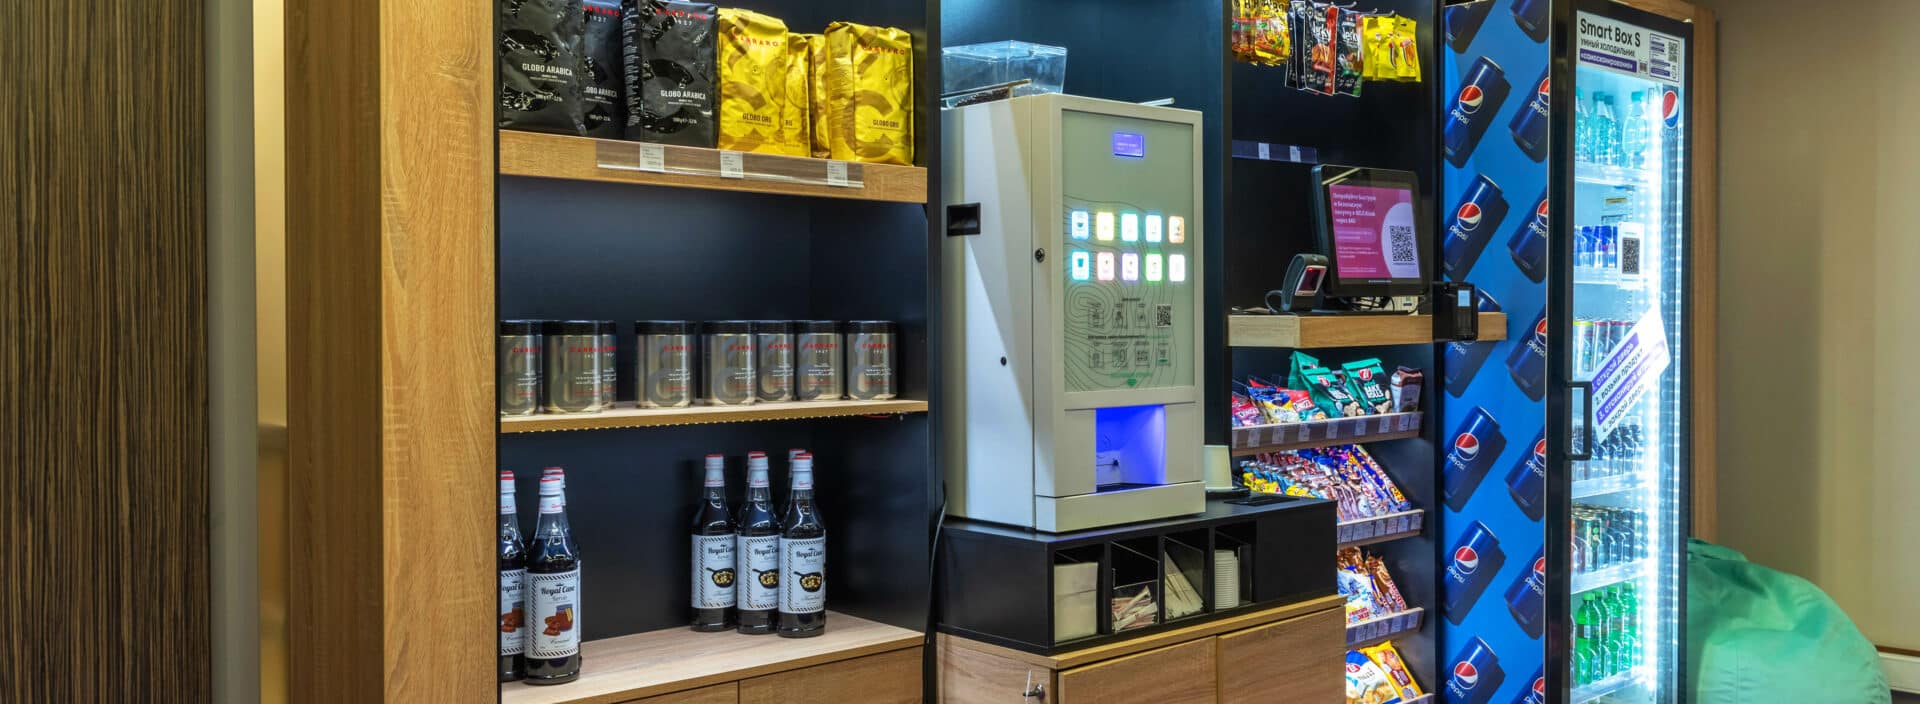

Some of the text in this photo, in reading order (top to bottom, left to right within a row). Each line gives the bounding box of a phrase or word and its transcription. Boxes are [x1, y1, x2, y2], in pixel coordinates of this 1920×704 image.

[1581, 18, 1612, 40] Smart
[1615, 28, 1632, 45] Box
[1635, 32, 1640, 47] S
[522, 64, 572, 76] GLOBO ARABICA
[682, 91, 706, 100] ARABICA
[742, 113, 760, 122] GLOBO
[872, 120, 889, 128] GLOBO
[1597, 358, 1616, 386] открой
[1617, 343, 1634, 364] дверь
[1602, 374, 1621, 399] возьми
[541, 586, 561, 596] Royal
